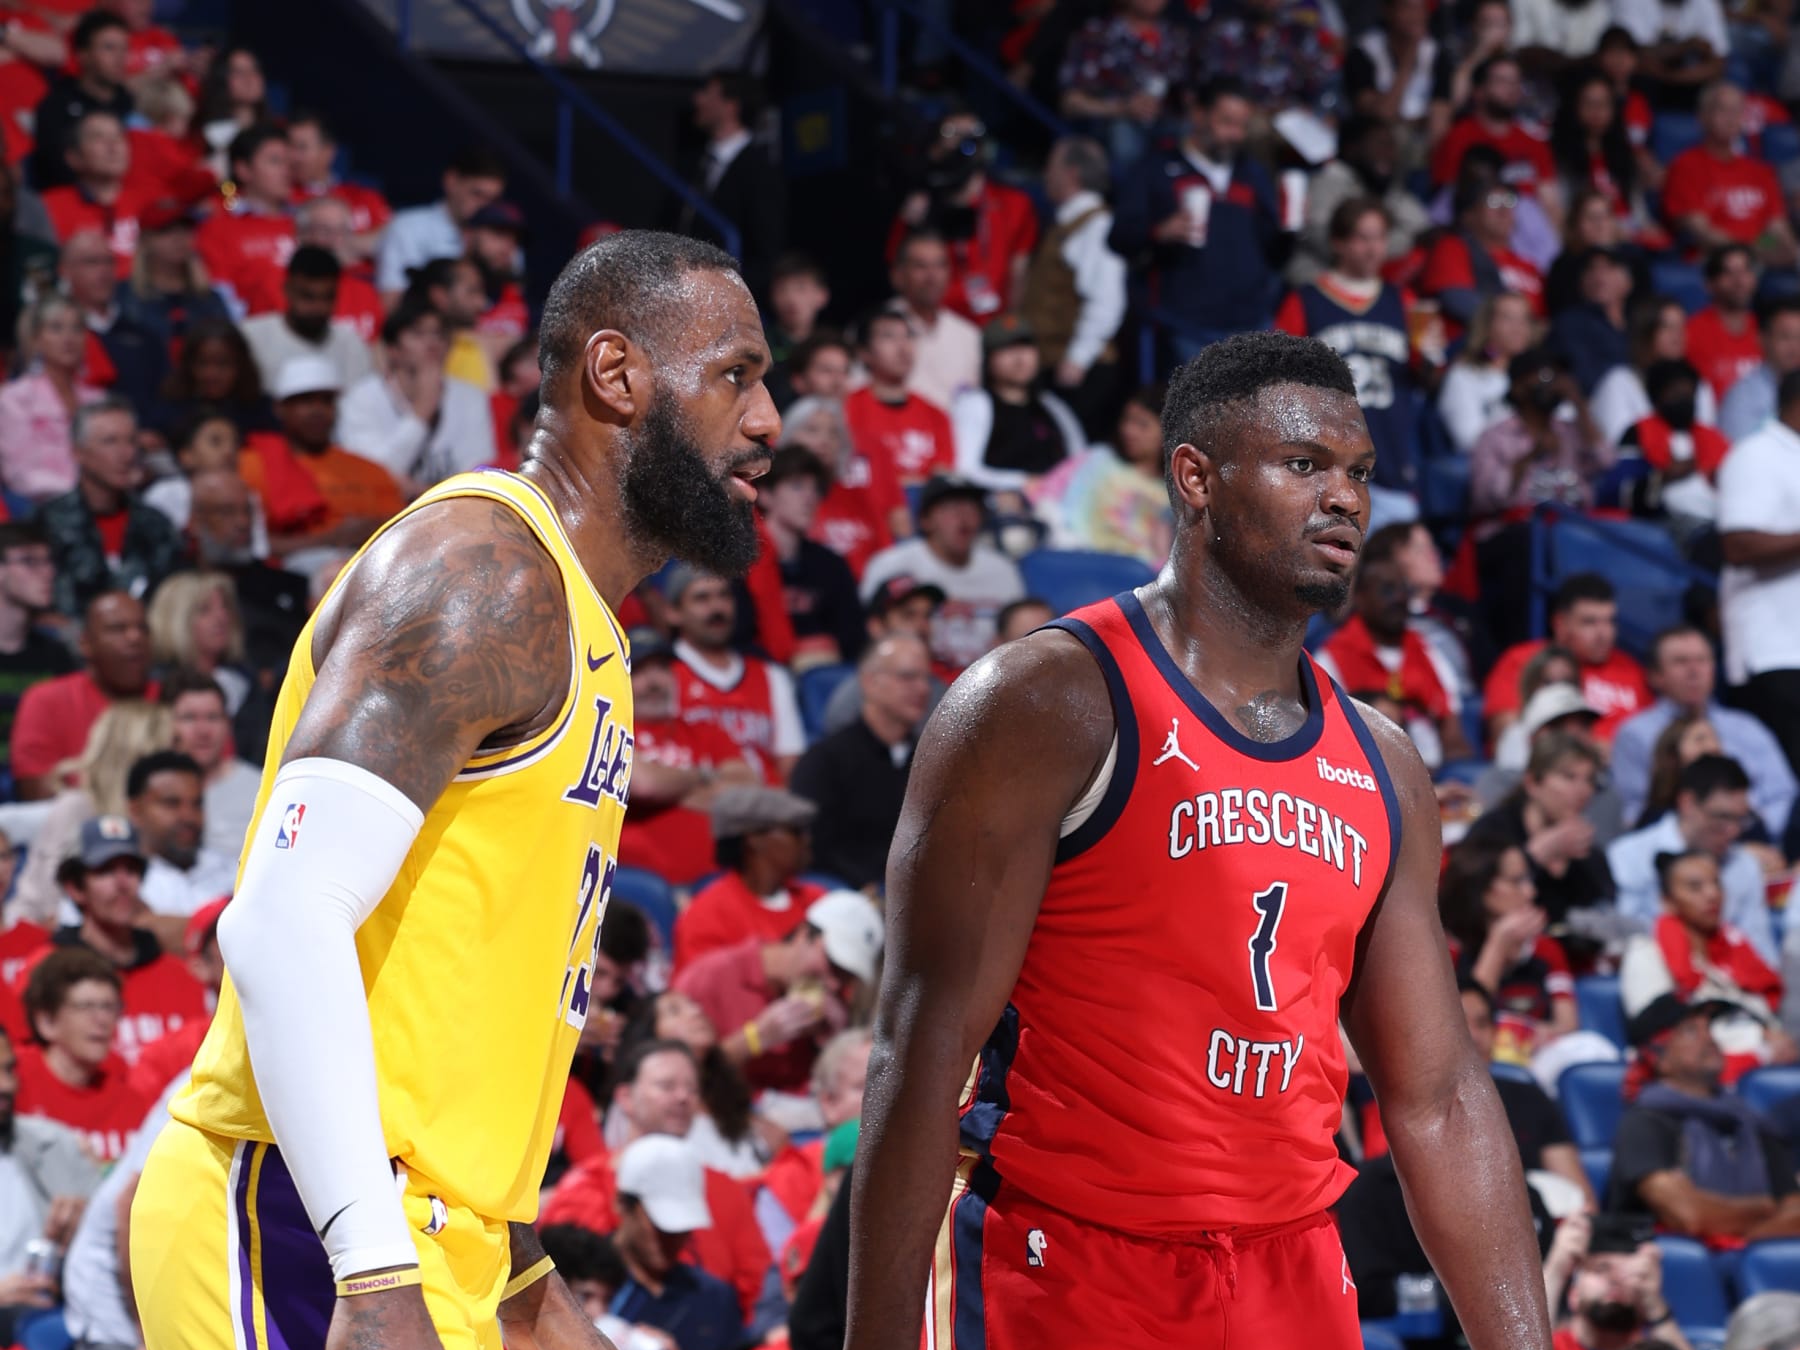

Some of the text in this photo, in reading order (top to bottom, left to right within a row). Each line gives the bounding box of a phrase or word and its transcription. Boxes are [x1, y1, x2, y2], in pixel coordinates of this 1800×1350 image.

[1316, 756, 1377, 792] ibotta
[1168, 788, 1368, 889] CRESCENT
[556, 840, 618, 1031] 23
[1248, 881, 1288, 1012] 1
[1206, 1028, 1304, 1098] CITY
[346, 1277, 396, 1292] PROMISE
